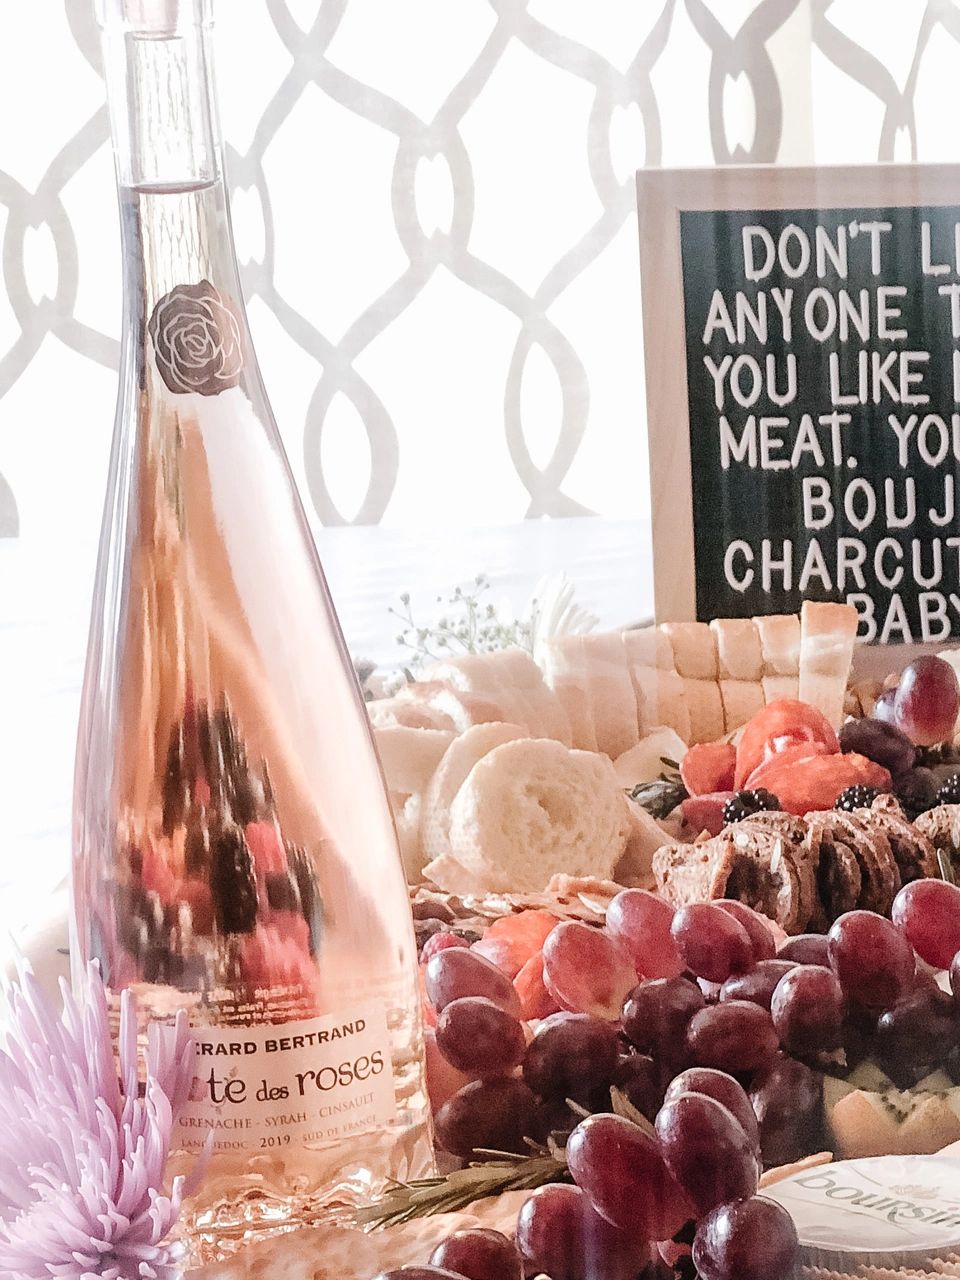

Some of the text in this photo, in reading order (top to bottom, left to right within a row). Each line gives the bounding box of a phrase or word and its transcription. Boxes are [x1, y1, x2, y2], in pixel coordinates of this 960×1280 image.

[741, 219, 892, 282] DON'T
[702, 286, 908, 345] ANYONE
[702, 351, 798, 409] YOU
[828, 350, 930, 406] LIKE
[719, 411, 858, 470] MEAT.
[195, 1019, 366, 1056] RARD BERTRAND
[255, 1079, 289, 1102] des
[295, 1050, 385, 1096] roses
[178, 1092, 375, 1130] GRENACHE SYRAH CINSAULT
[260, 1134, 291, 1148] 2019
[302, 1131, 323, 1142] SUD
